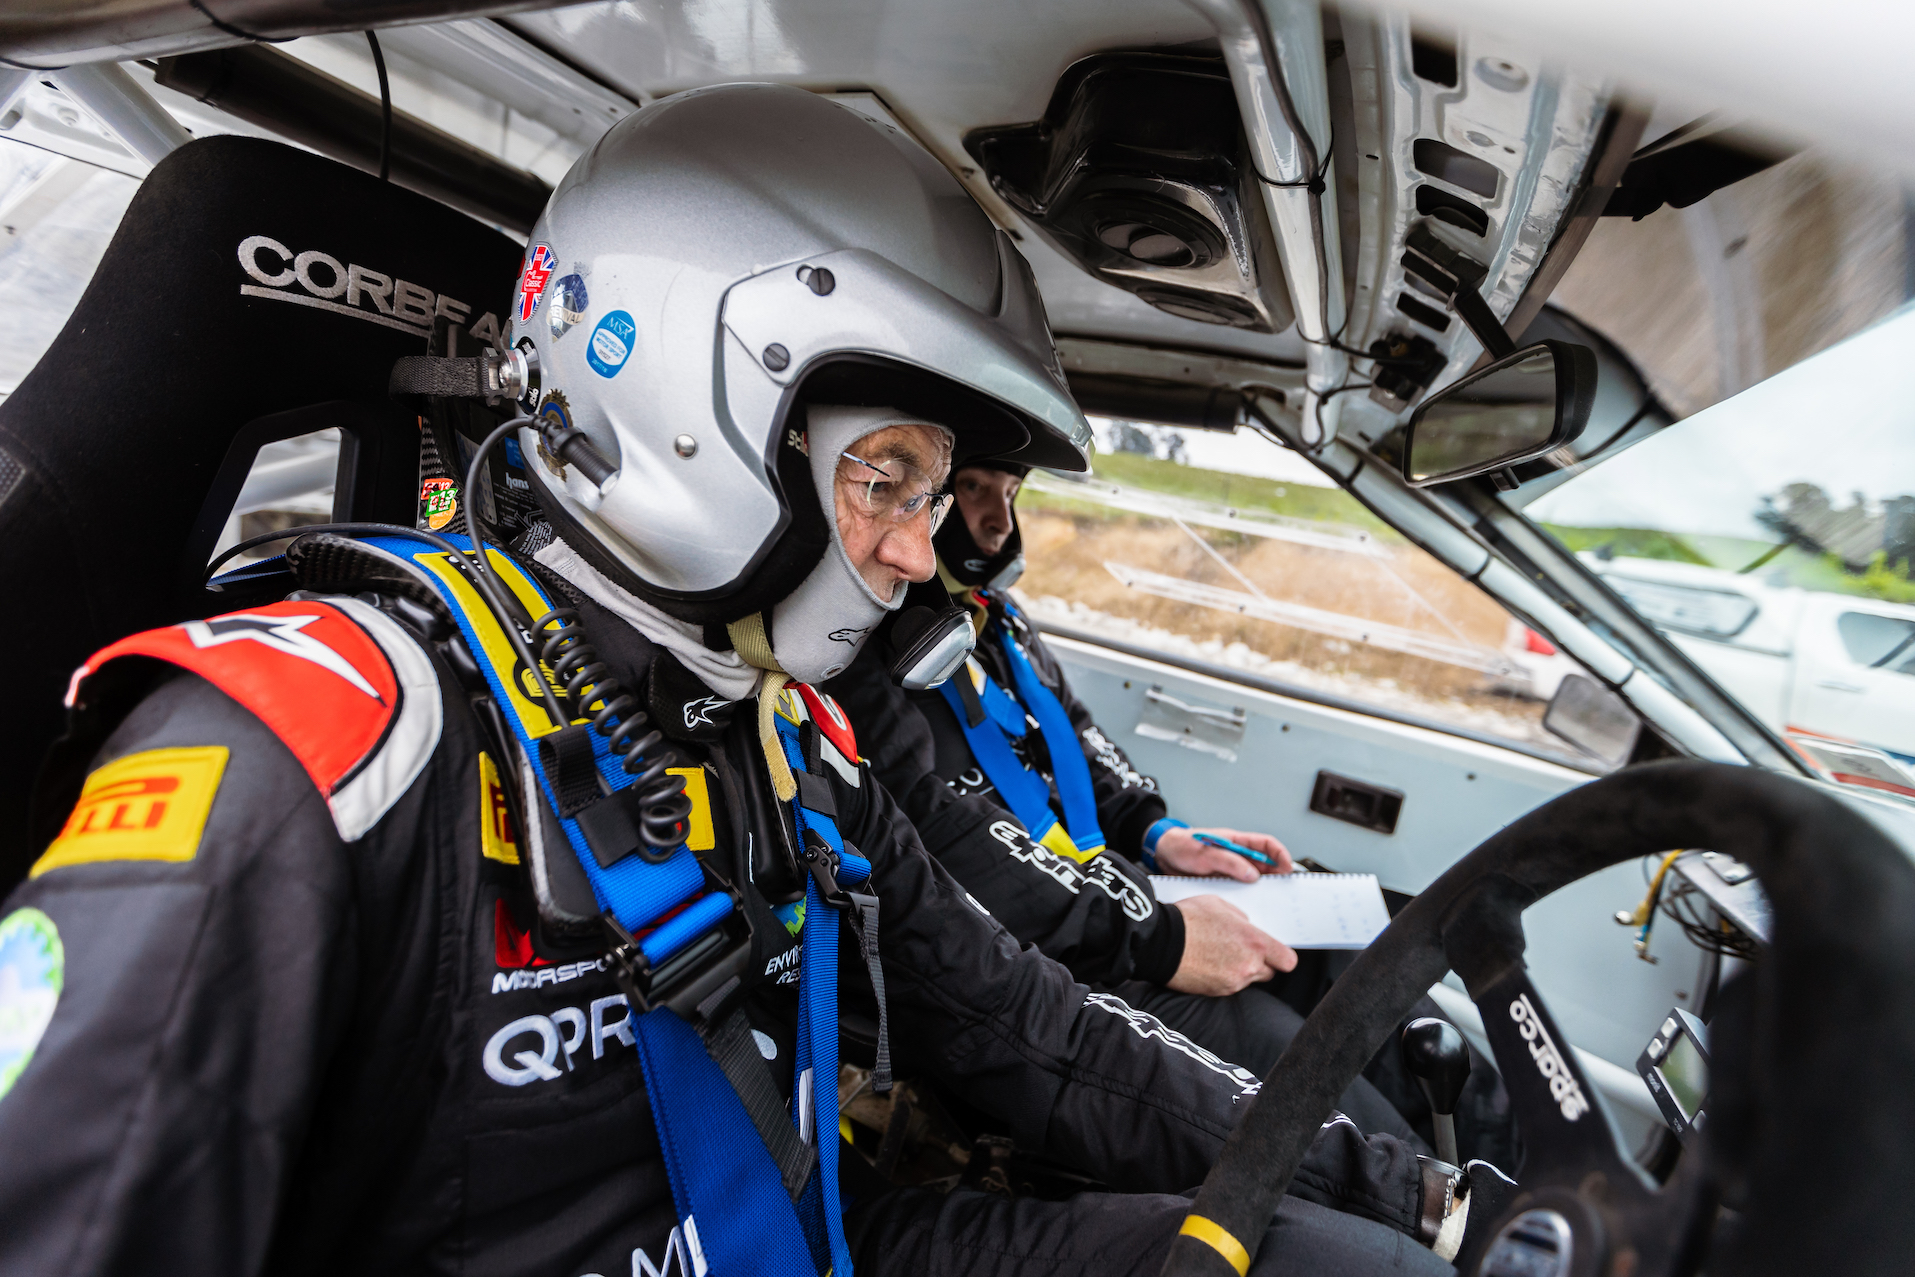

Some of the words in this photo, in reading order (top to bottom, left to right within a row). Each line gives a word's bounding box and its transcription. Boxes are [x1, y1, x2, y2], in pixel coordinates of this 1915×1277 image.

[237, 235, 512, 349] CORBEA
[606, 316, 628, 340] MSA
[1508, 994, 1590, 1122] sparco
